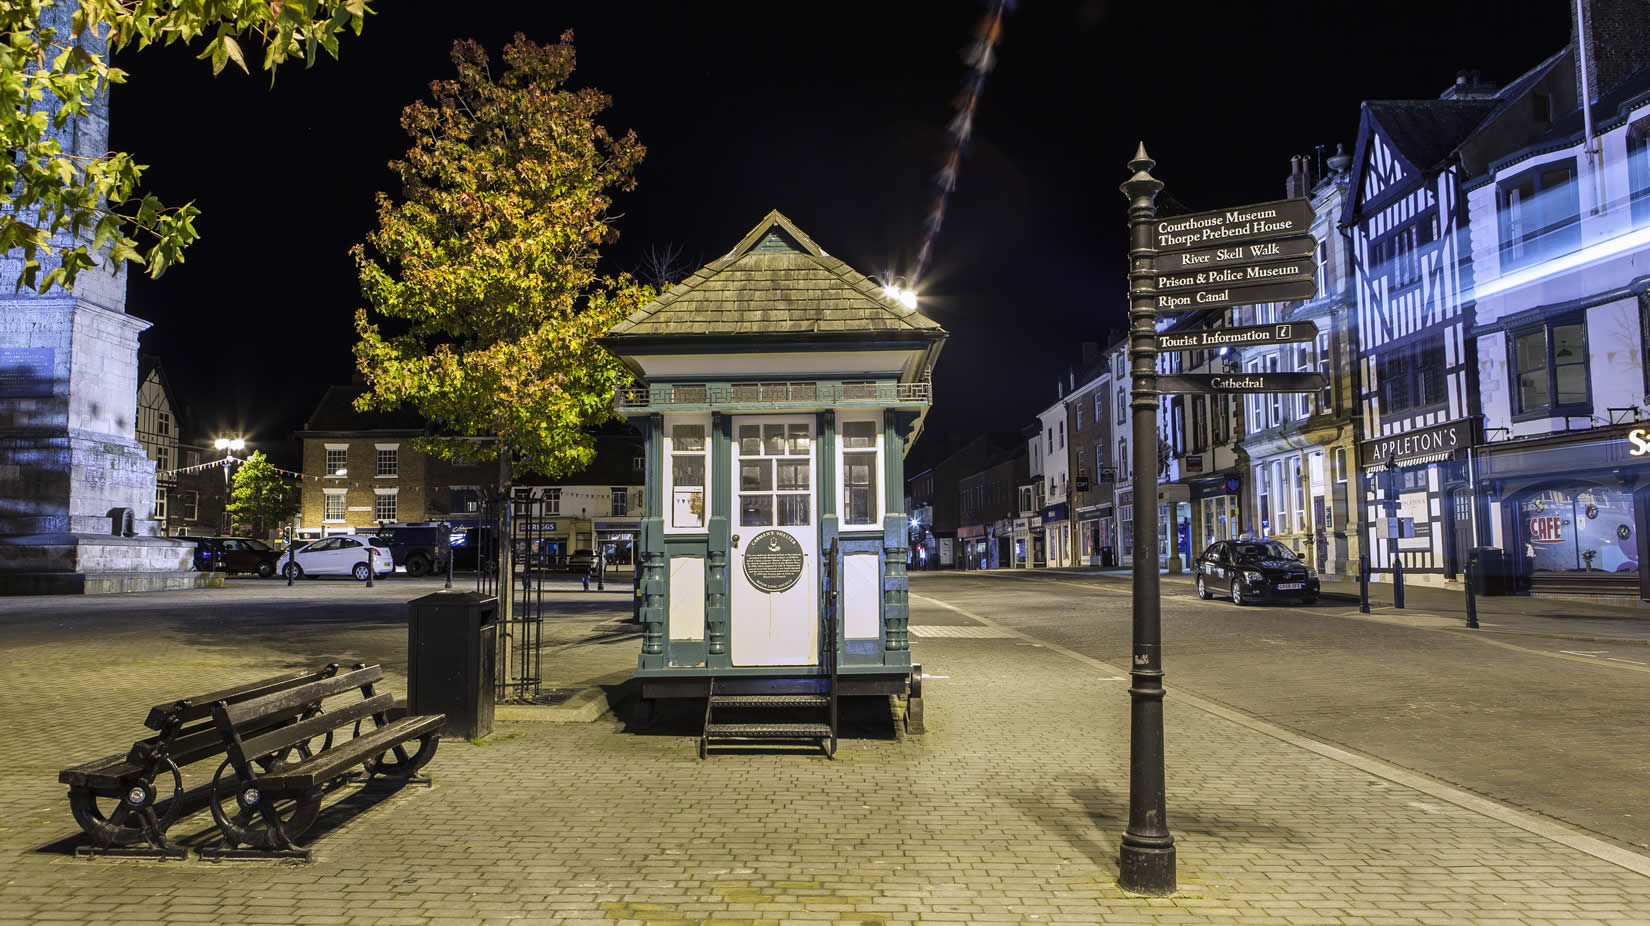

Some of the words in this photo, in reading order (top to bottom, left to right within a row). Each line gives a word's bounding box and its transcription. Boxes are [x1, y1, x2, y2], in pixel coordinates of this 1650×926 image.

[1158, 216, 1223, 234] Courthouse
[1225, 209, 1276, 224] Museum
[1159, 230, 1201, 246] Thorpe
[1202, 223, 1250, 241] Prebend
[1253, 219, 1293, 233] House
[1182, 254, 1210, 265] River
[1216, 248, 1243, 261] Skell
[1250, 243, 1280, 256] Walk
[1158, 277, 1194, 288] Prison
[1196, 274, 1206, 283] &
[1209, 270, 1243, 283] Police
[1246, 265, 1299, 278] Museum
[1159, 296, 1191, 308] Ripon
[1197, 289, 1229, 303] Canal
[1160, 336, 1198, 348] Tourist
[1202, 331, 1270, 344] Information
[1211, 377, 1264, 389] Cathedral
[1373, 428, 1457, 460] APPLETON'S
